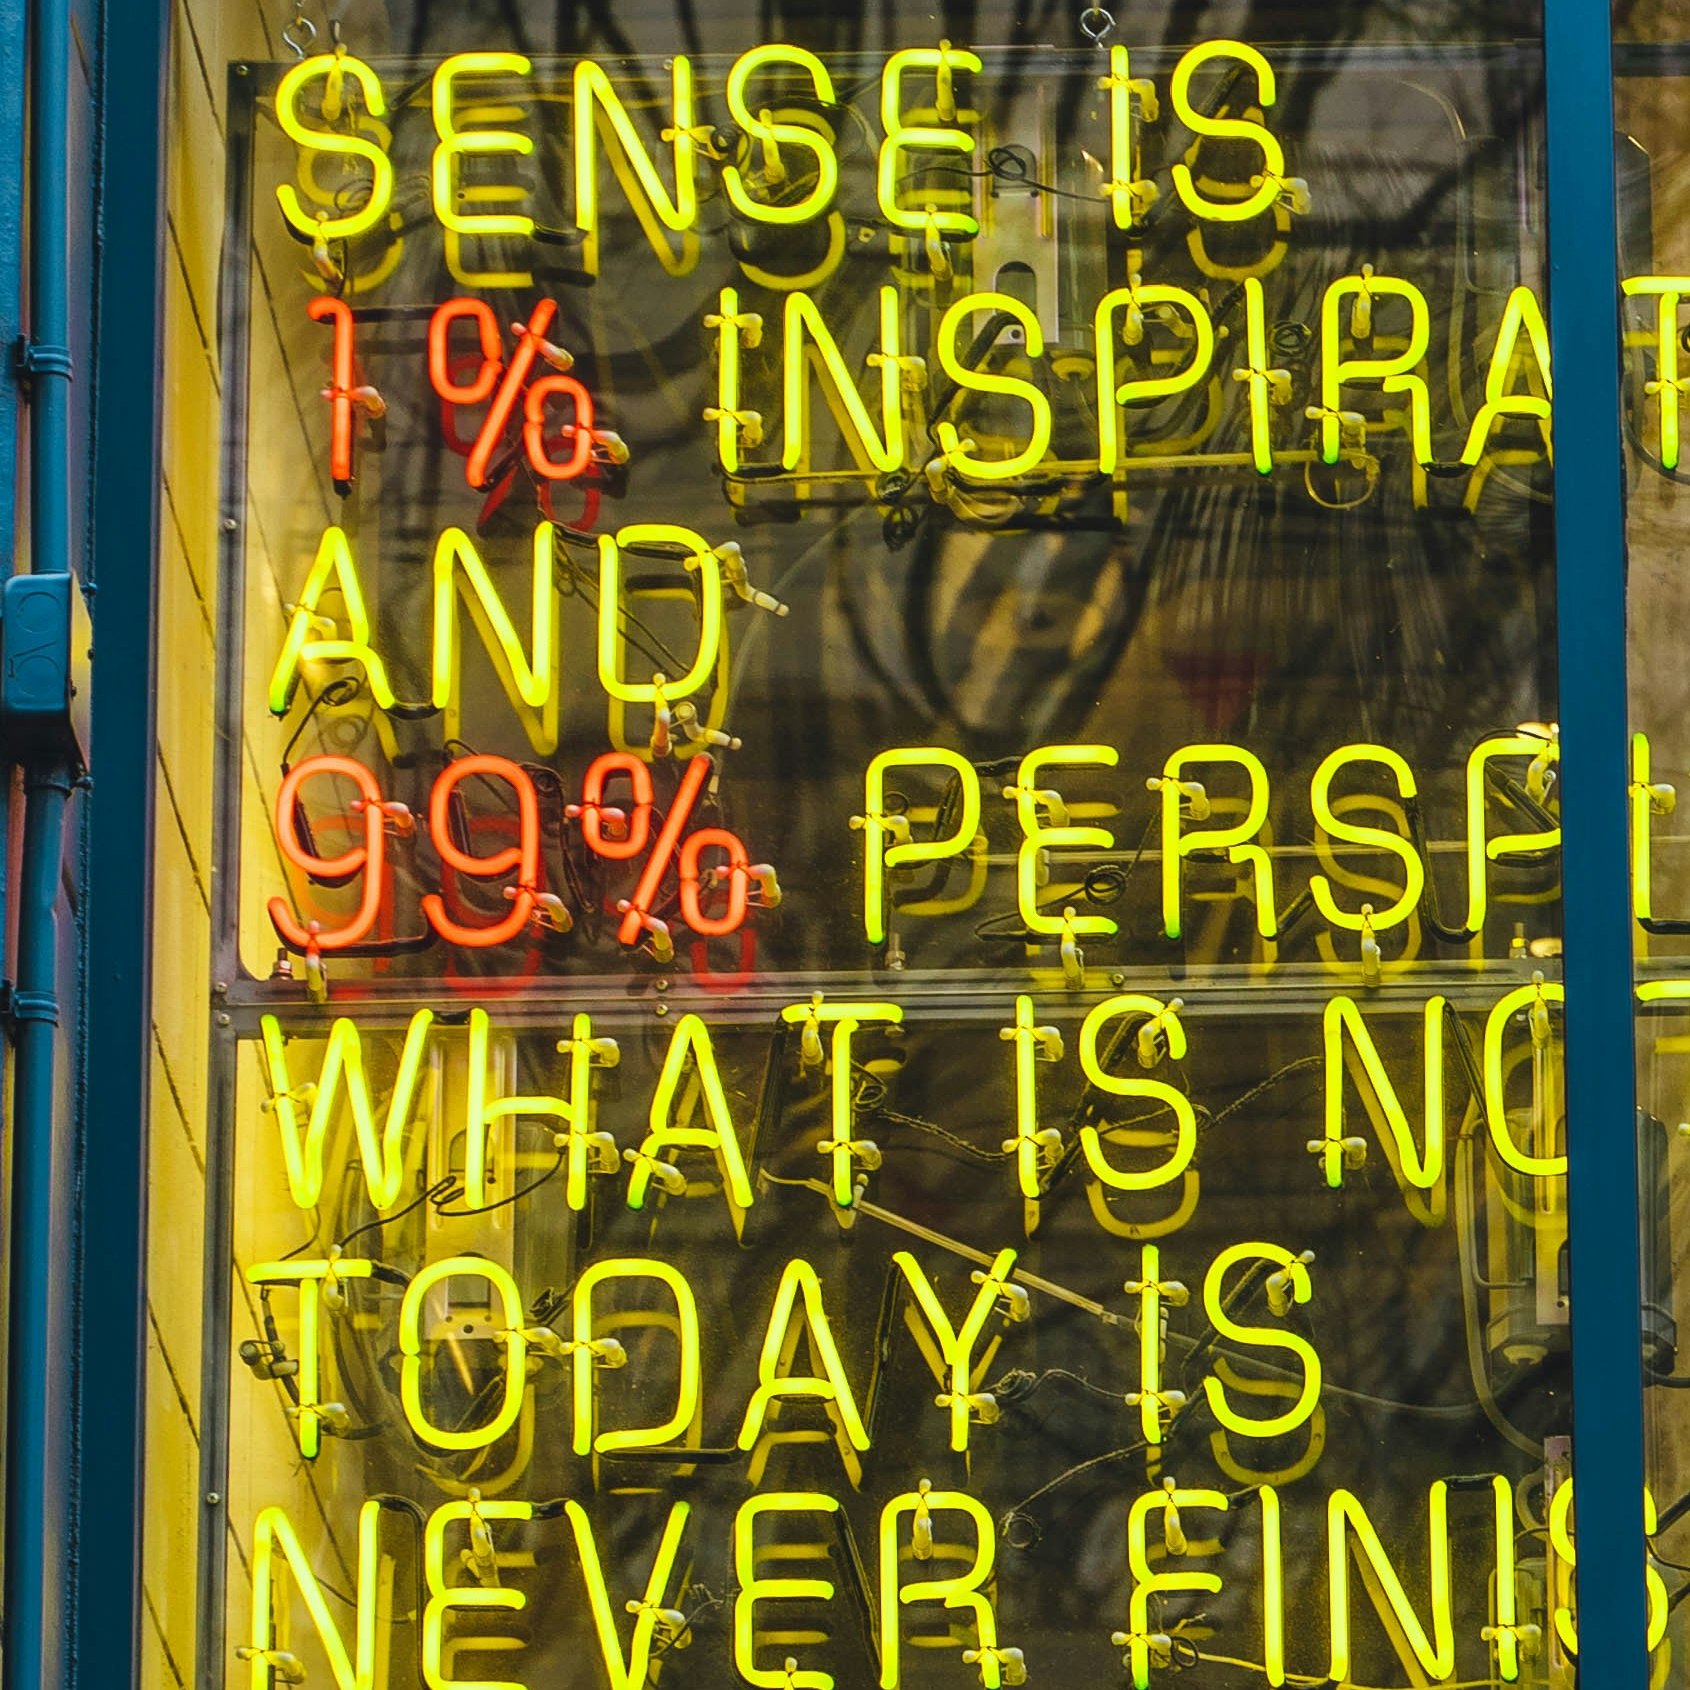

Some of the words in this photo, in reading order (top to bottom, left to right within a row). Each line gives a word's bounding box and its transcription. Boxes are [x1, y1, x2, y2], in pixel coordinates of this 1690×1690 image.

[273, 41, 984, 239] SENSE
[1109, 39, 1281, 232] IS
[307, 294, 600, 490] 1%
[267, 521, 727, 716] AND
[267, 749, 750, 952] 99%
[260, 1001, 905, 1211] WHAT
[1015, 993, 1199, 1199] IS
[245, 1246, 1019, 1462] TODAY
[1138, 1240, 1324, 1446] IS
